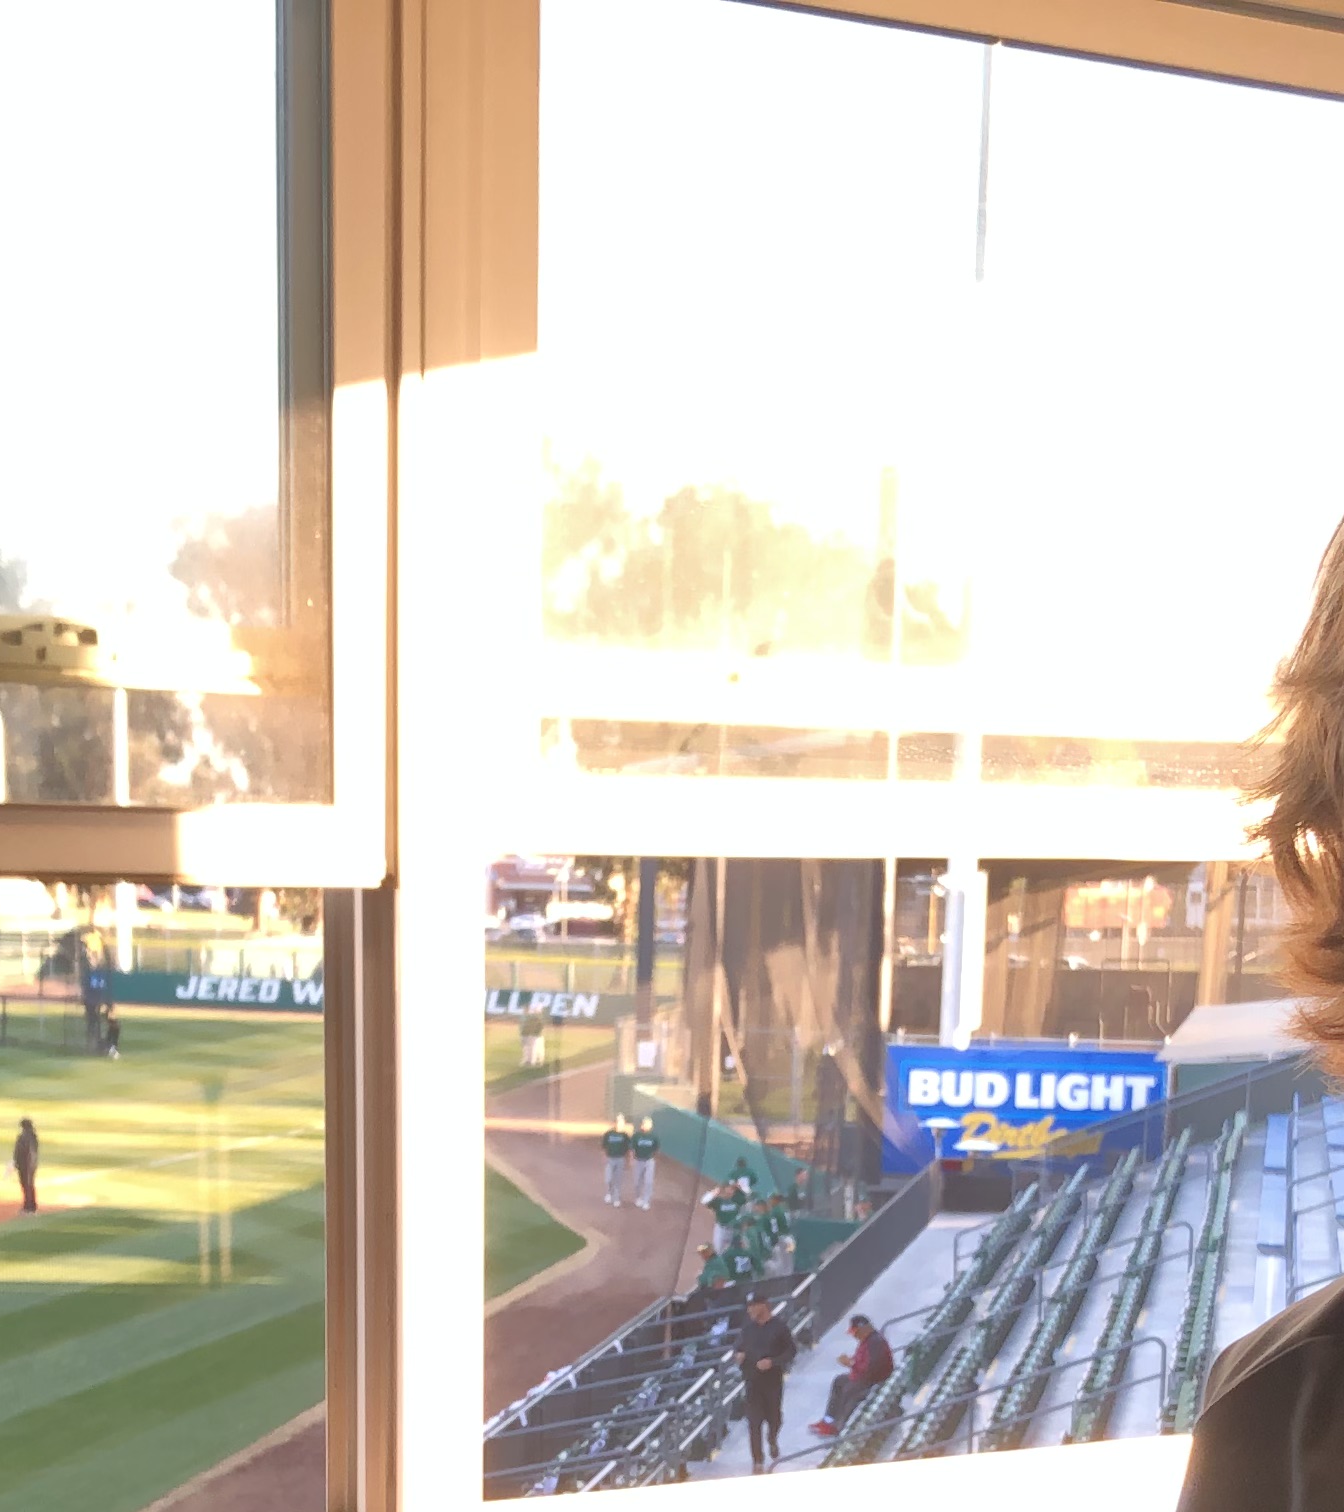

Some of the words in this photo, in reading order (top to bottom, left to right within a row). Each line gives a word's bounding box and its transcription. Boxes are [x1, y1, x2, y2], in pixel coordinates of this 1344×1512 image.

[175, 975, 281, 1003] JERED
[292, 979, 325, 1006] W
[486, 989, 599, 1018] LLPEN
[908, 1068, 1010, 1108] BUD
[1014, 1071, 1156, 1112] LIGHT
